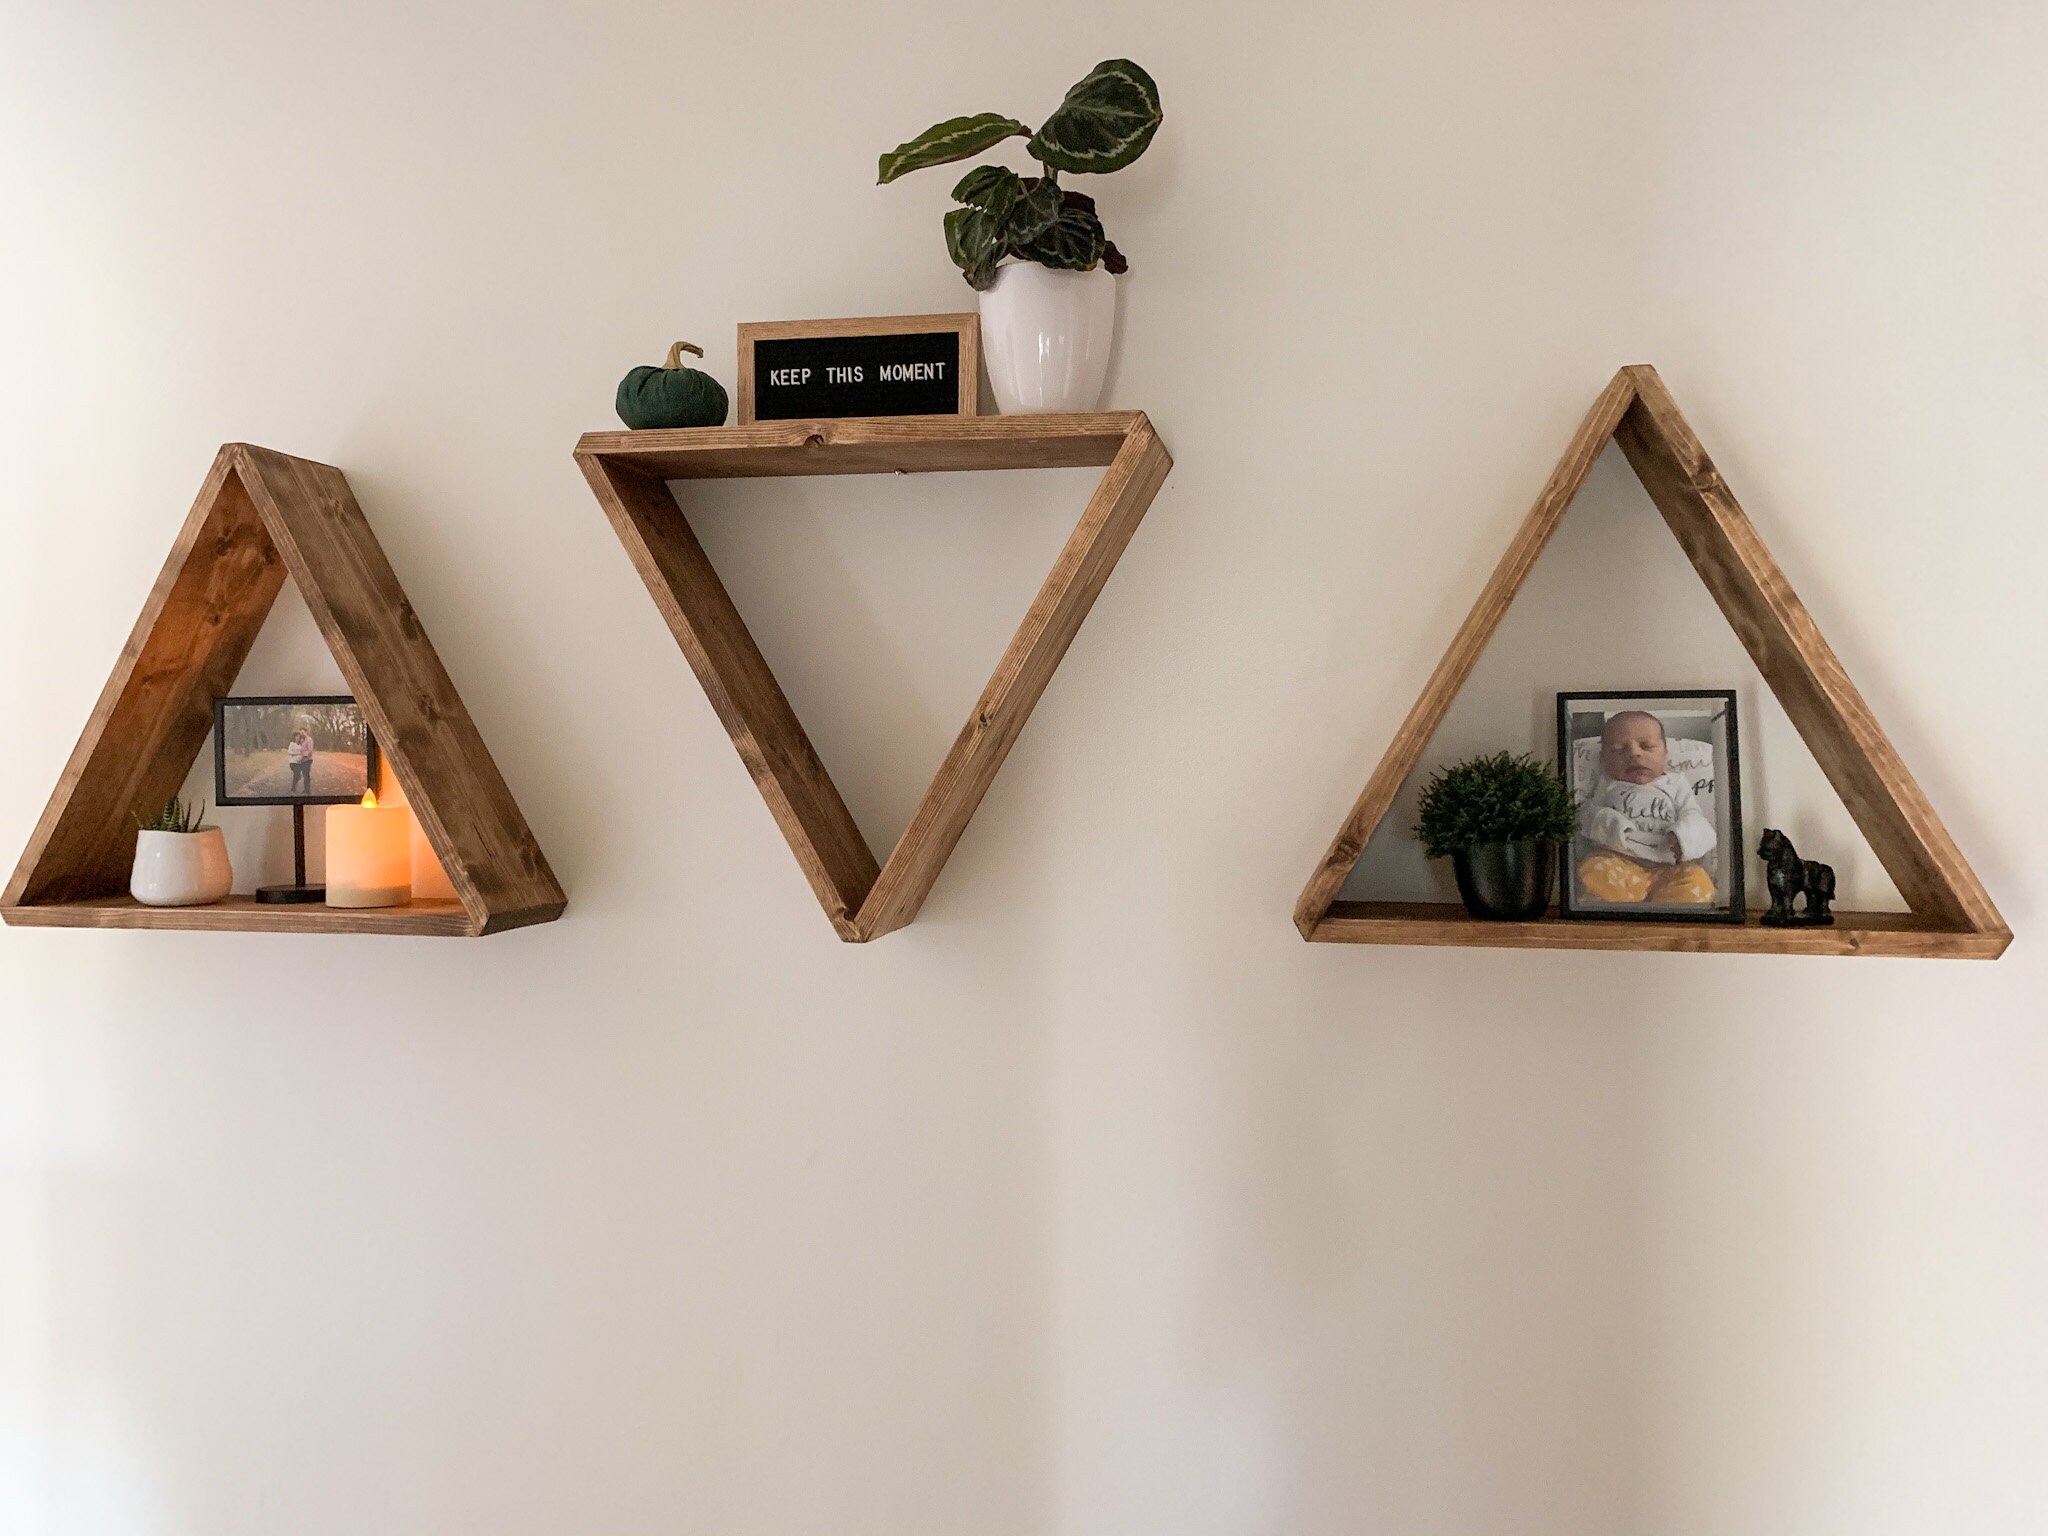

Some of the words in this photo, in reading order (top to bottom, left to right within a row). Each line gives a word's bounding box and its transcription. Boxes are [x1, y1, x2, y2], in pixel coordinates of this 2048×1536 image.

[770, 368, 812, 386] KEEP
[826, 366, 864, 384] THIS
[879, 362, 946, 382] MOMENT
